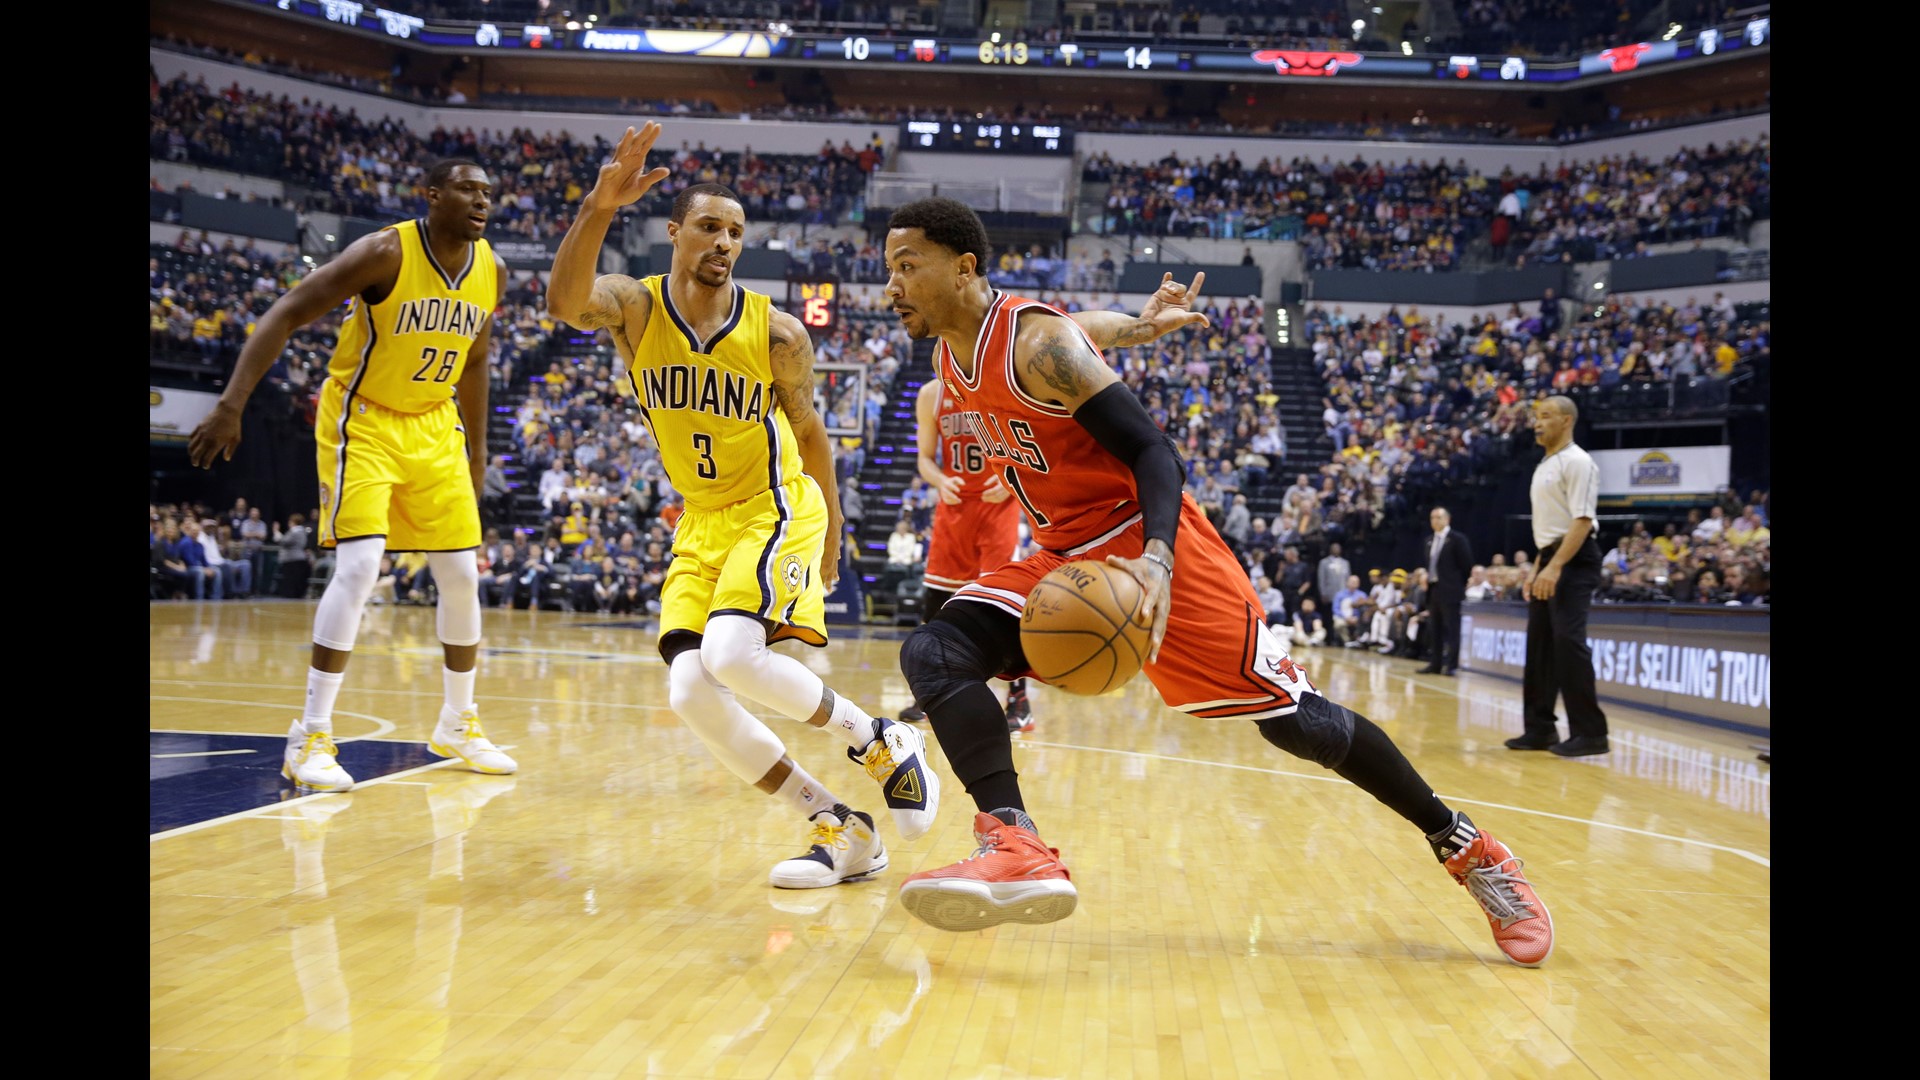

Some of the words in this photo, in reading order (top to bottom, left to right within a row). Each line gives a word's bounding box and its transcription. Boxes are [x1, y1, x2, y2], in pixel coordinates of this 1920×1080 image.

[842, 37, 870, 61] 10
[978, 41, 1029, 65] 6:13
[1124, 46, 1152, 70] 14
[804, 298, 831, 327] 15
[411, 346, 459, 383] 28
[641, 365, 765, 424] INDIANA
[692, 433, 718, 480] 3
[951, 441, 985, 474] 16
[1004, 465, 1052, 528] 1
[1639, 642, 1718, 700] SELLING
